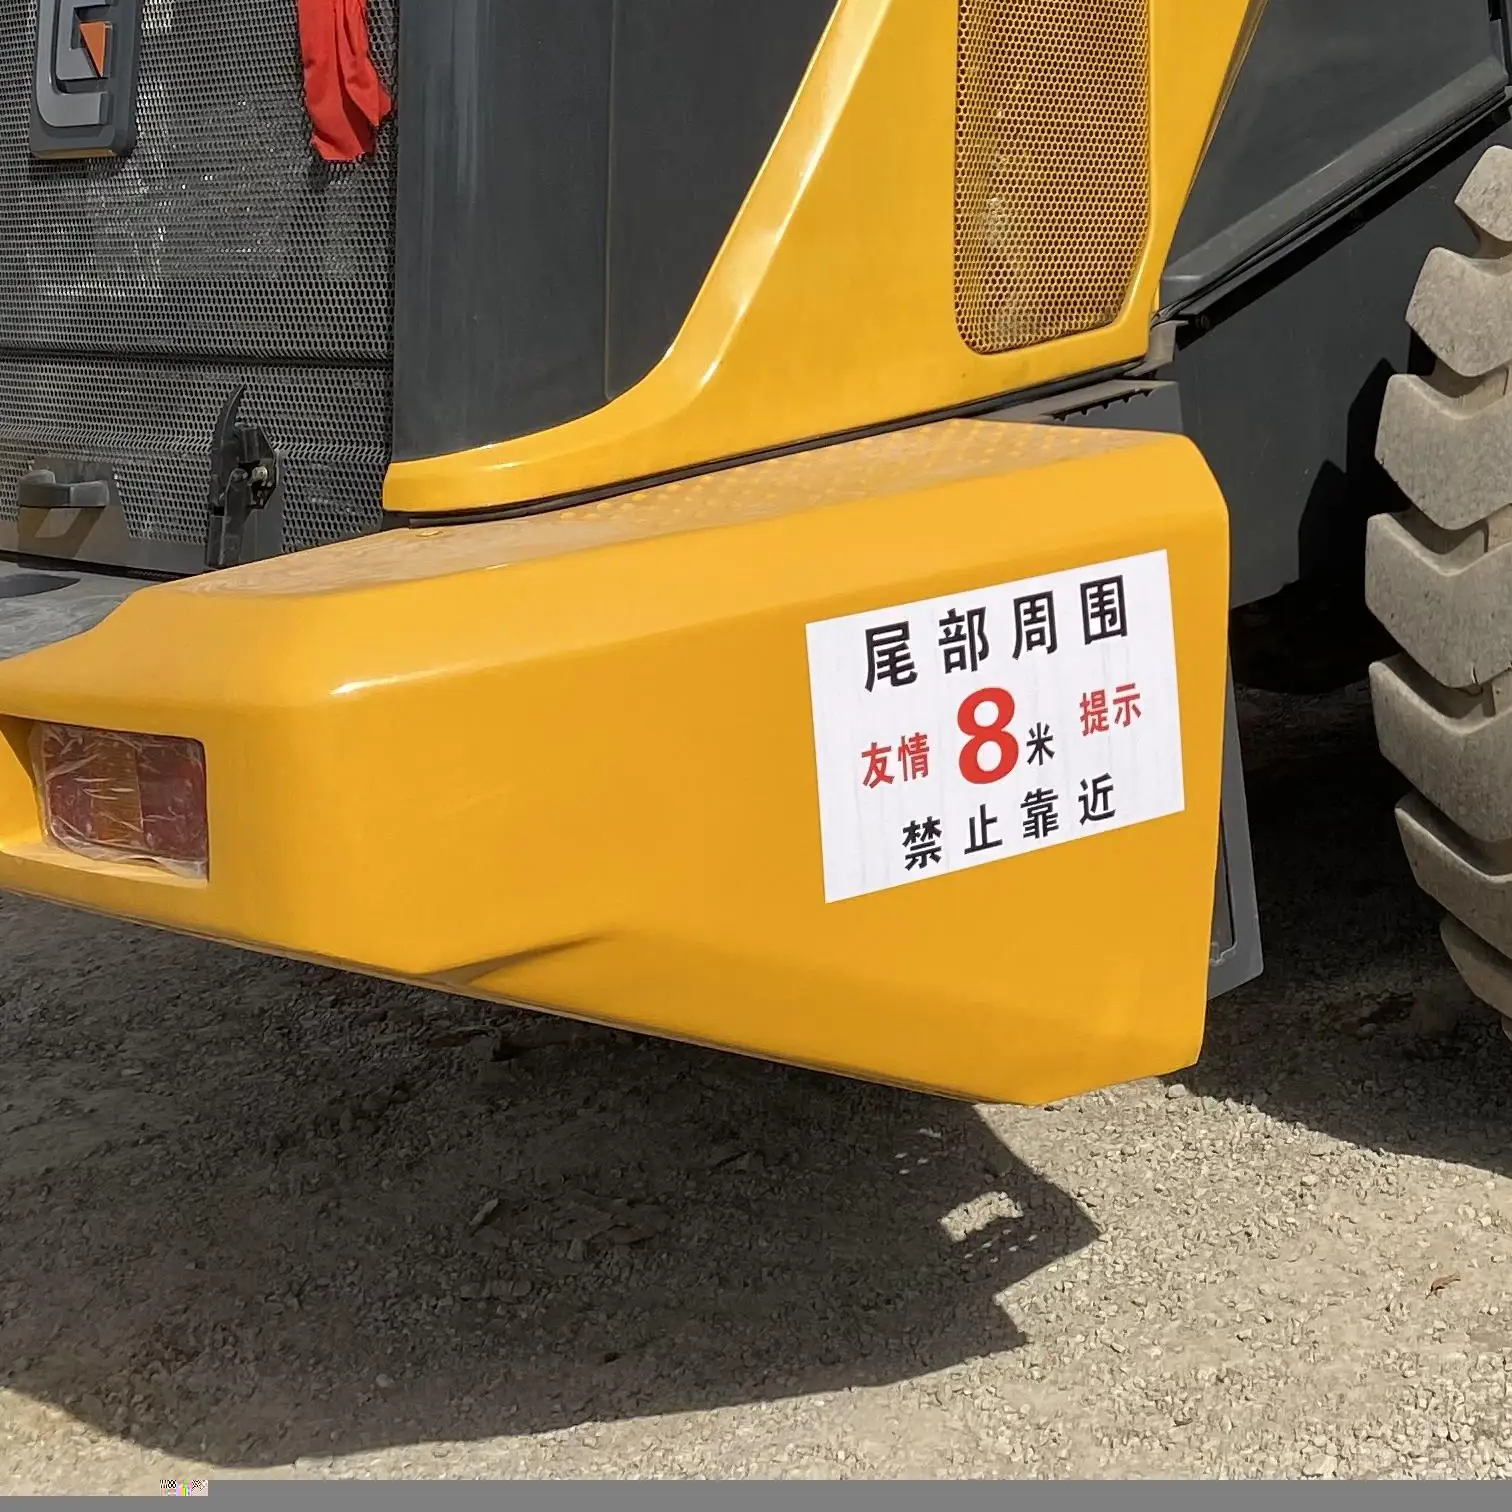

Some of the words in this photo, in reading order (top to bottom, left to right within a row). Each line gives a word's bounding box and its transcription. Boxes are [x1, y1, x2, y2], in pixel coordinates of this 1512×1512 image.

[864, 574, 1129, 692] 尾部周围
[861, 732, 930, 789] 友情
[1079, 682, 1142, 736] 提示
[902, 772, 1117, 871] 禁止靠近
